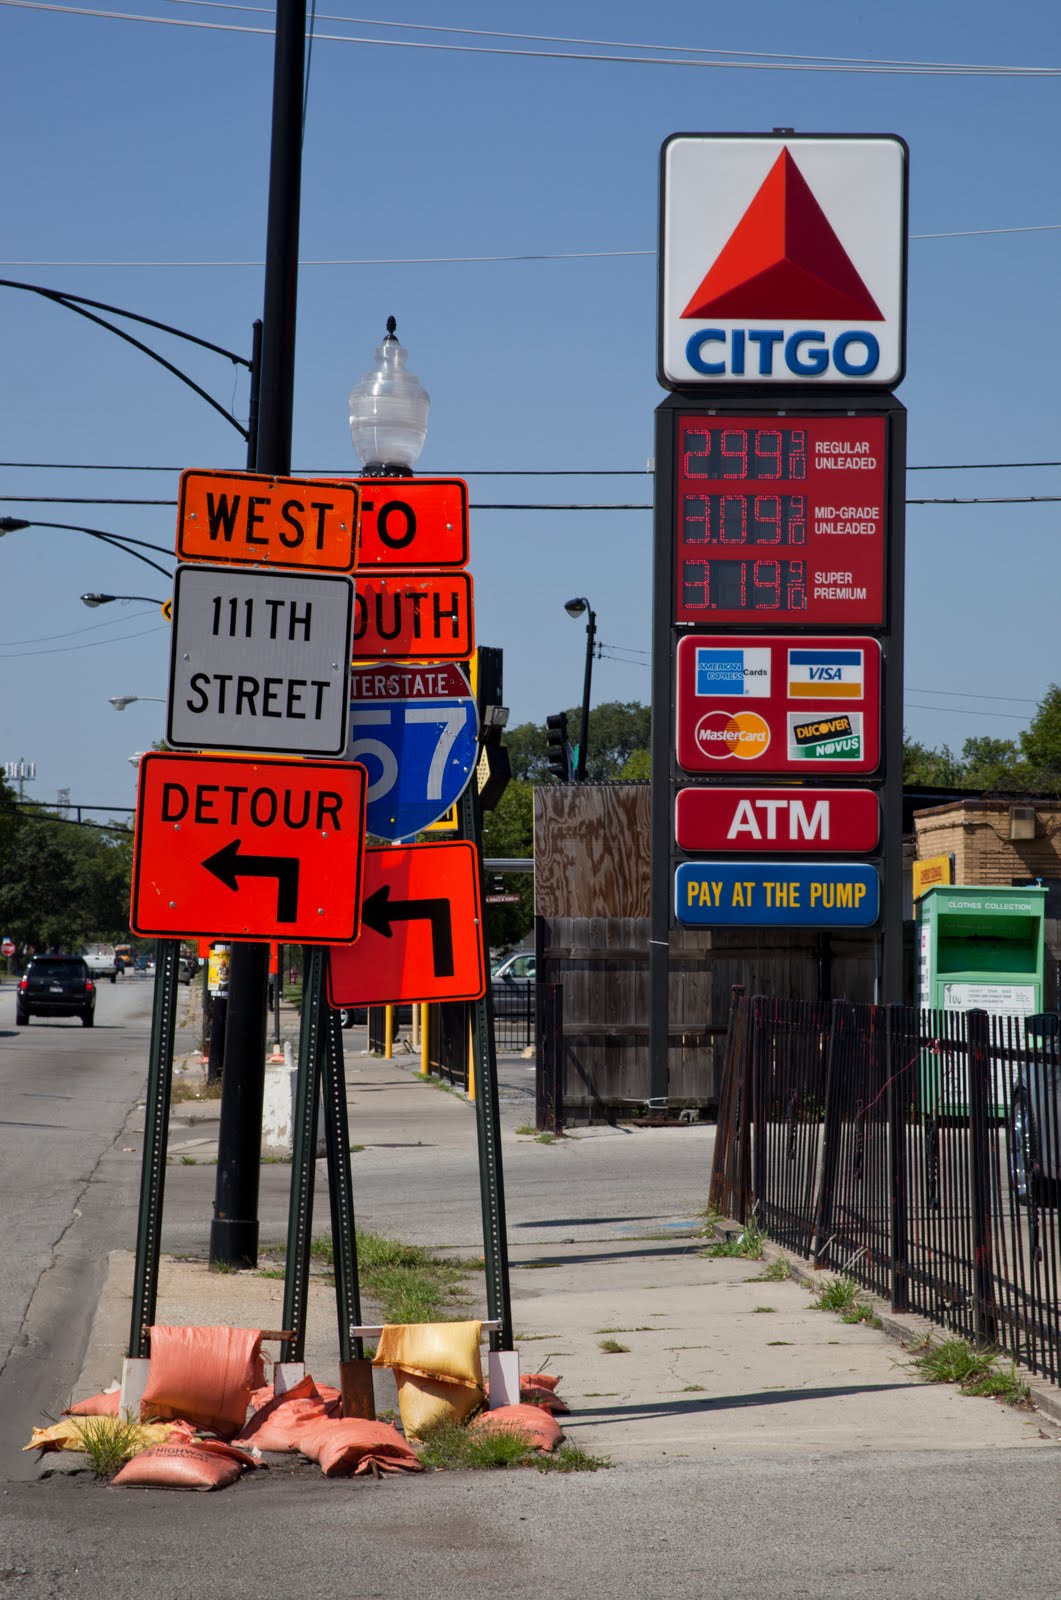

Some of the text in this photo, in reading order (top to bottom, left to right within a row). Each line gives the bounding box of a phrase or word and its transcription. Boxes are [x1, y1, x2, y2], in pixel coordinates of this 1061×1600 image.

[685, 328, 880, 376] CITGO
[815, 441, 870, 454] REGULAR
[815, 457, 877, 470] UNLEADED
[206, 492, 334, 550] WEST
[814, 507, 880, 519] MID-GRADE
[360, 500, 417, 550] O
[814, 523, 876, 535] UNLEADED
[814, 572, 853, 584] SUPER
[814, 588, 867, 600] PREMIUM
[212, 596, 312, 642] 111TH
[353, 592, 460, 641] OUTH
[698, 662, 742, 671] AMERICAN
[706, 672, 744, 680] EXPRESS
[743, 668, 768, 676] Cards
[808, 667, 843, 681] VISA
[350, 673, 449, 697] TERSTATE
[186, 673, 331, 720] STREET
[699, 728, 767, 742] MasterCard
[796, 718, 849, 740] DISCOVER
[349, 707, 467, 804] 57
[815, 738, 859, 757] NOVUS
[161, 782, 343, 831] DETOUR
[726, 799, 830, 840] ATM
[687, 881, 866, 908] PAY AT THE PUMP
[948, 901, 1032, 911] CLOTHES COLLECTION
